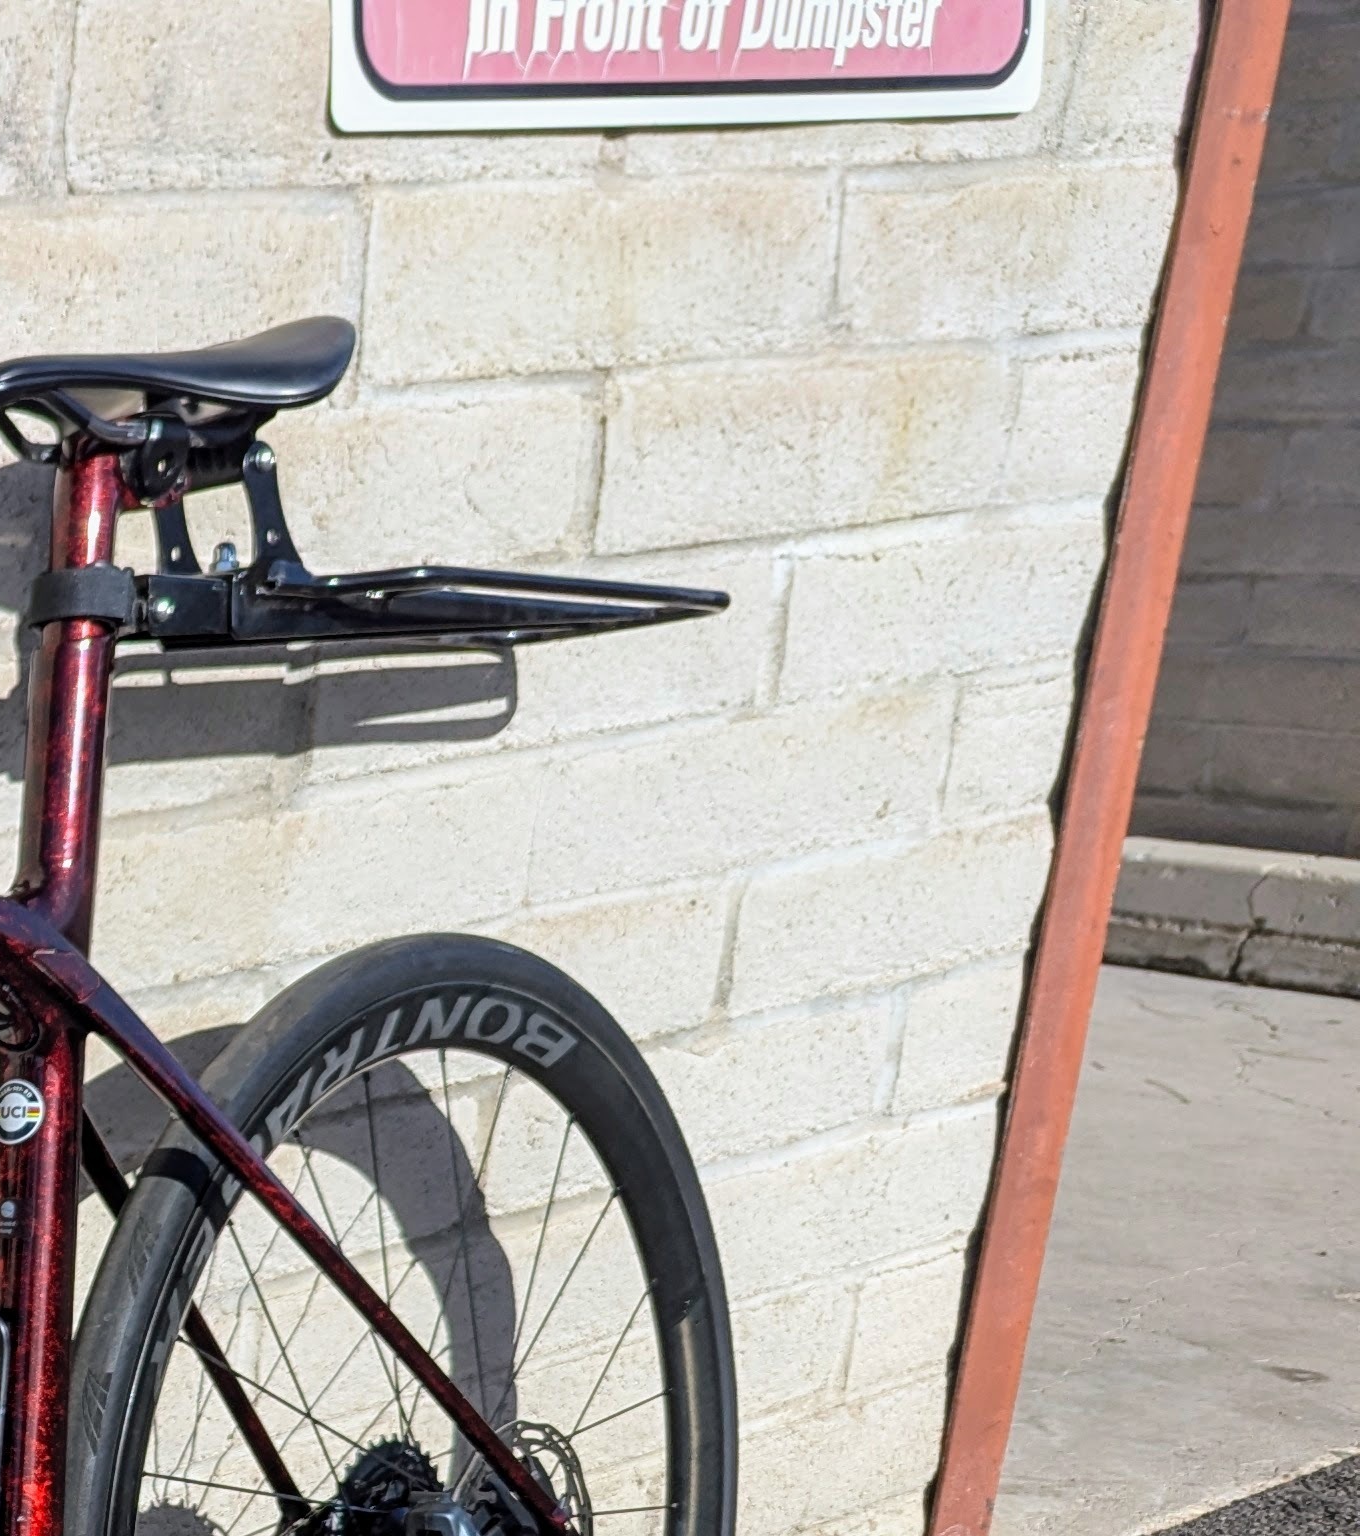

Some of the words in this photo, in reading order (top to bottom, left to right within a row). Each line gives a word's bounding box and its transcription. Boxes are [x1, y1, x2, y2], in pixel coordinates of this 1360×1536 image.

[532, 0, 666, 52] Front
[739, 0, 942, 66] Dumpster
[0, 1105, 27, 1119] UCI
